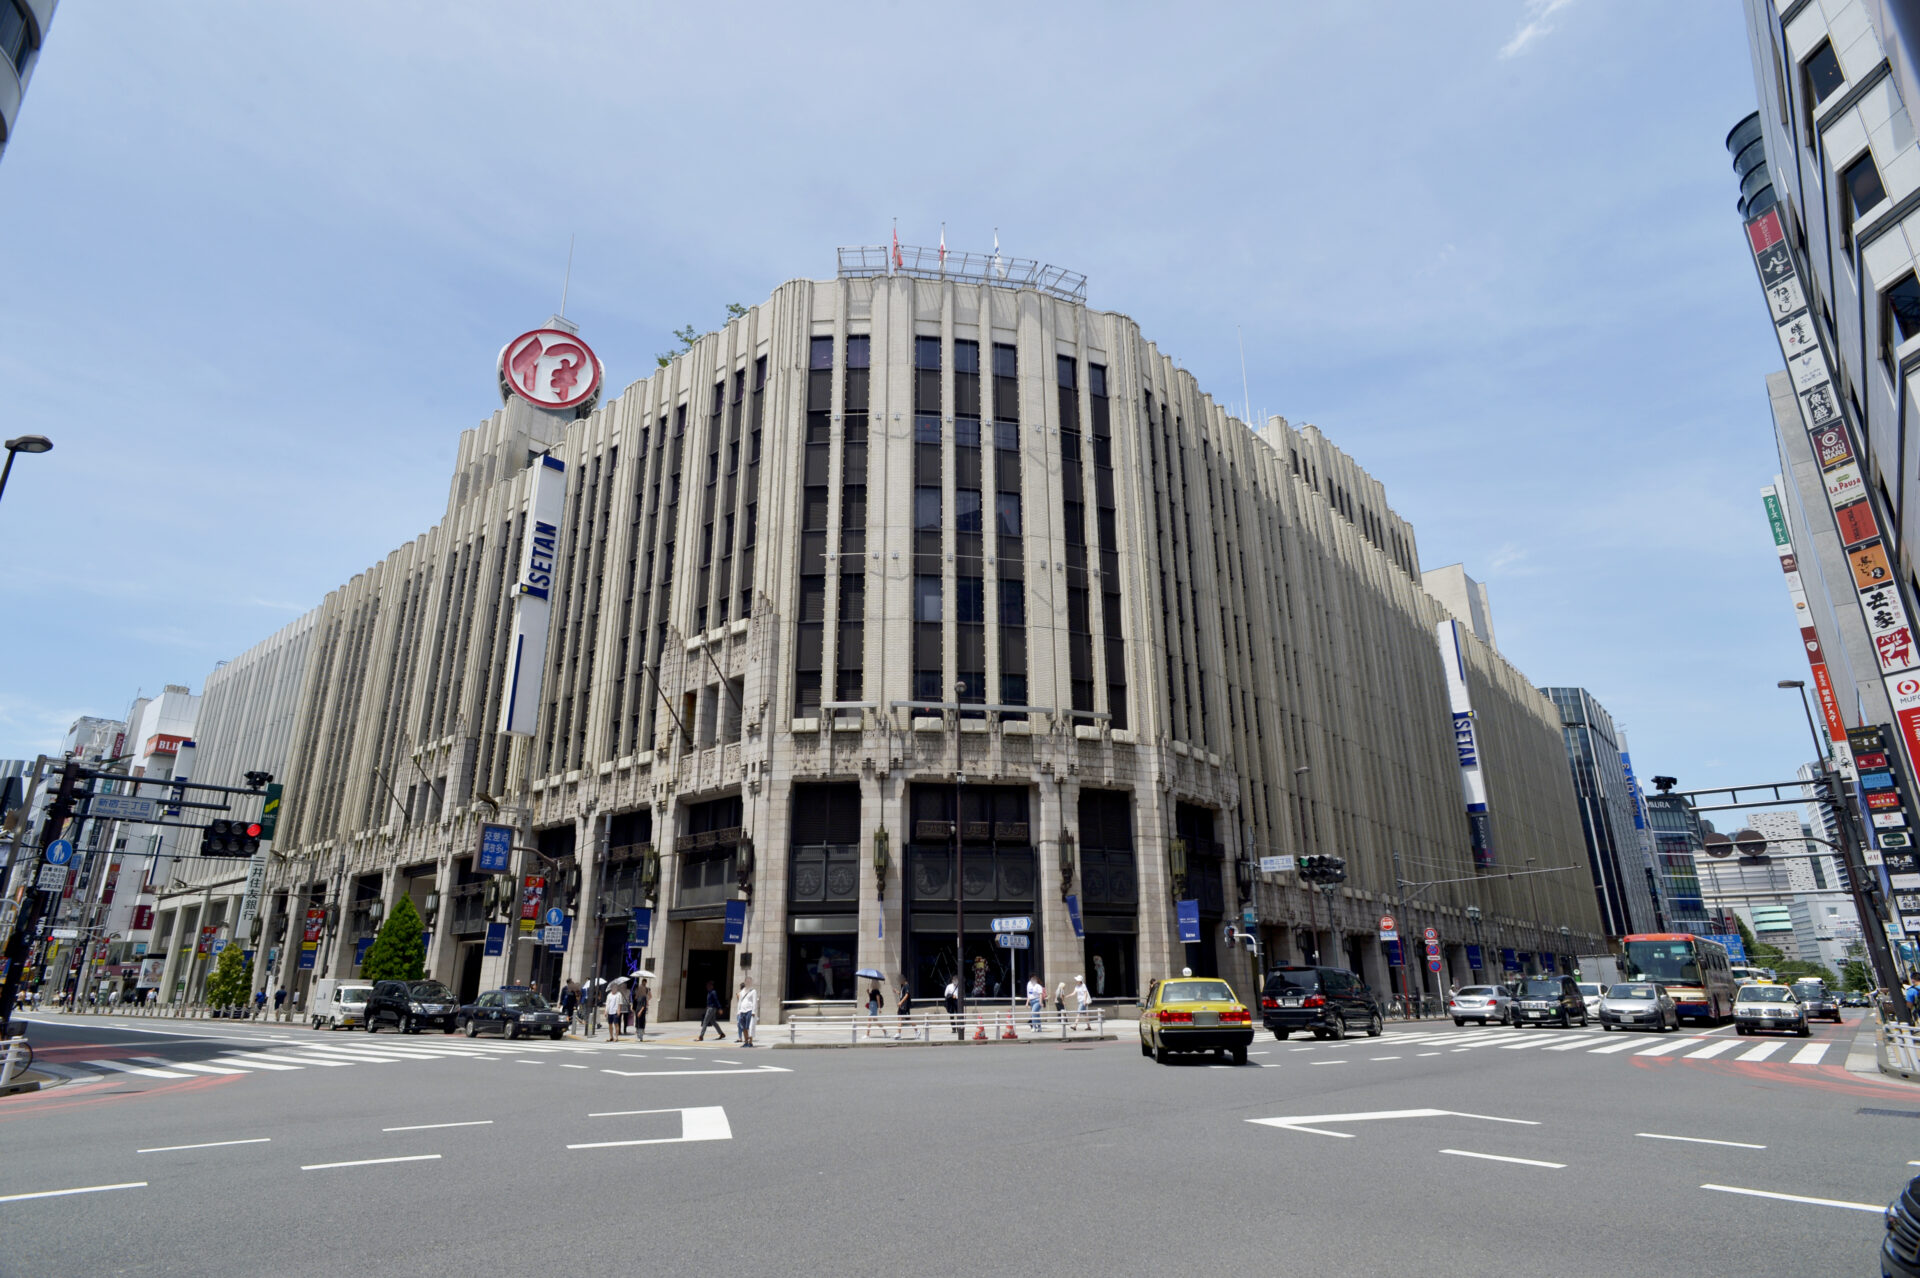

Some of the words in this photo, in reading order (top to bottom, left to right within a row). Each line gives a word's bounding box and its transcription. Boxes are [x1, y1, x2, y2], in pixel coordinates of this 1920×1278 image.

[1774, 287, 1793, 313] ねぎし
[1822, 442, 1845, 456] NIJYU
[1824, 448, 1847, 462] MARU
[1828, 483, 1839, 495] La
[1839, 476, 1861, 491] Pausa
[520, 520, 558, 601] ISETAN
[1866, 592, 1895, 629] 丑家
[1880, 633, 1902, 645] バル
[1453, 710, 1478, 768] ISETAN
[99, 798, 151, 811] 新宿三丁目
[484, 831, 510, 842] 交差点
[482, 843, 508, 855] 事故多し
[481, 855, 505, 866] 注意
[243, 856, 267, 921] 三井住友銀行
